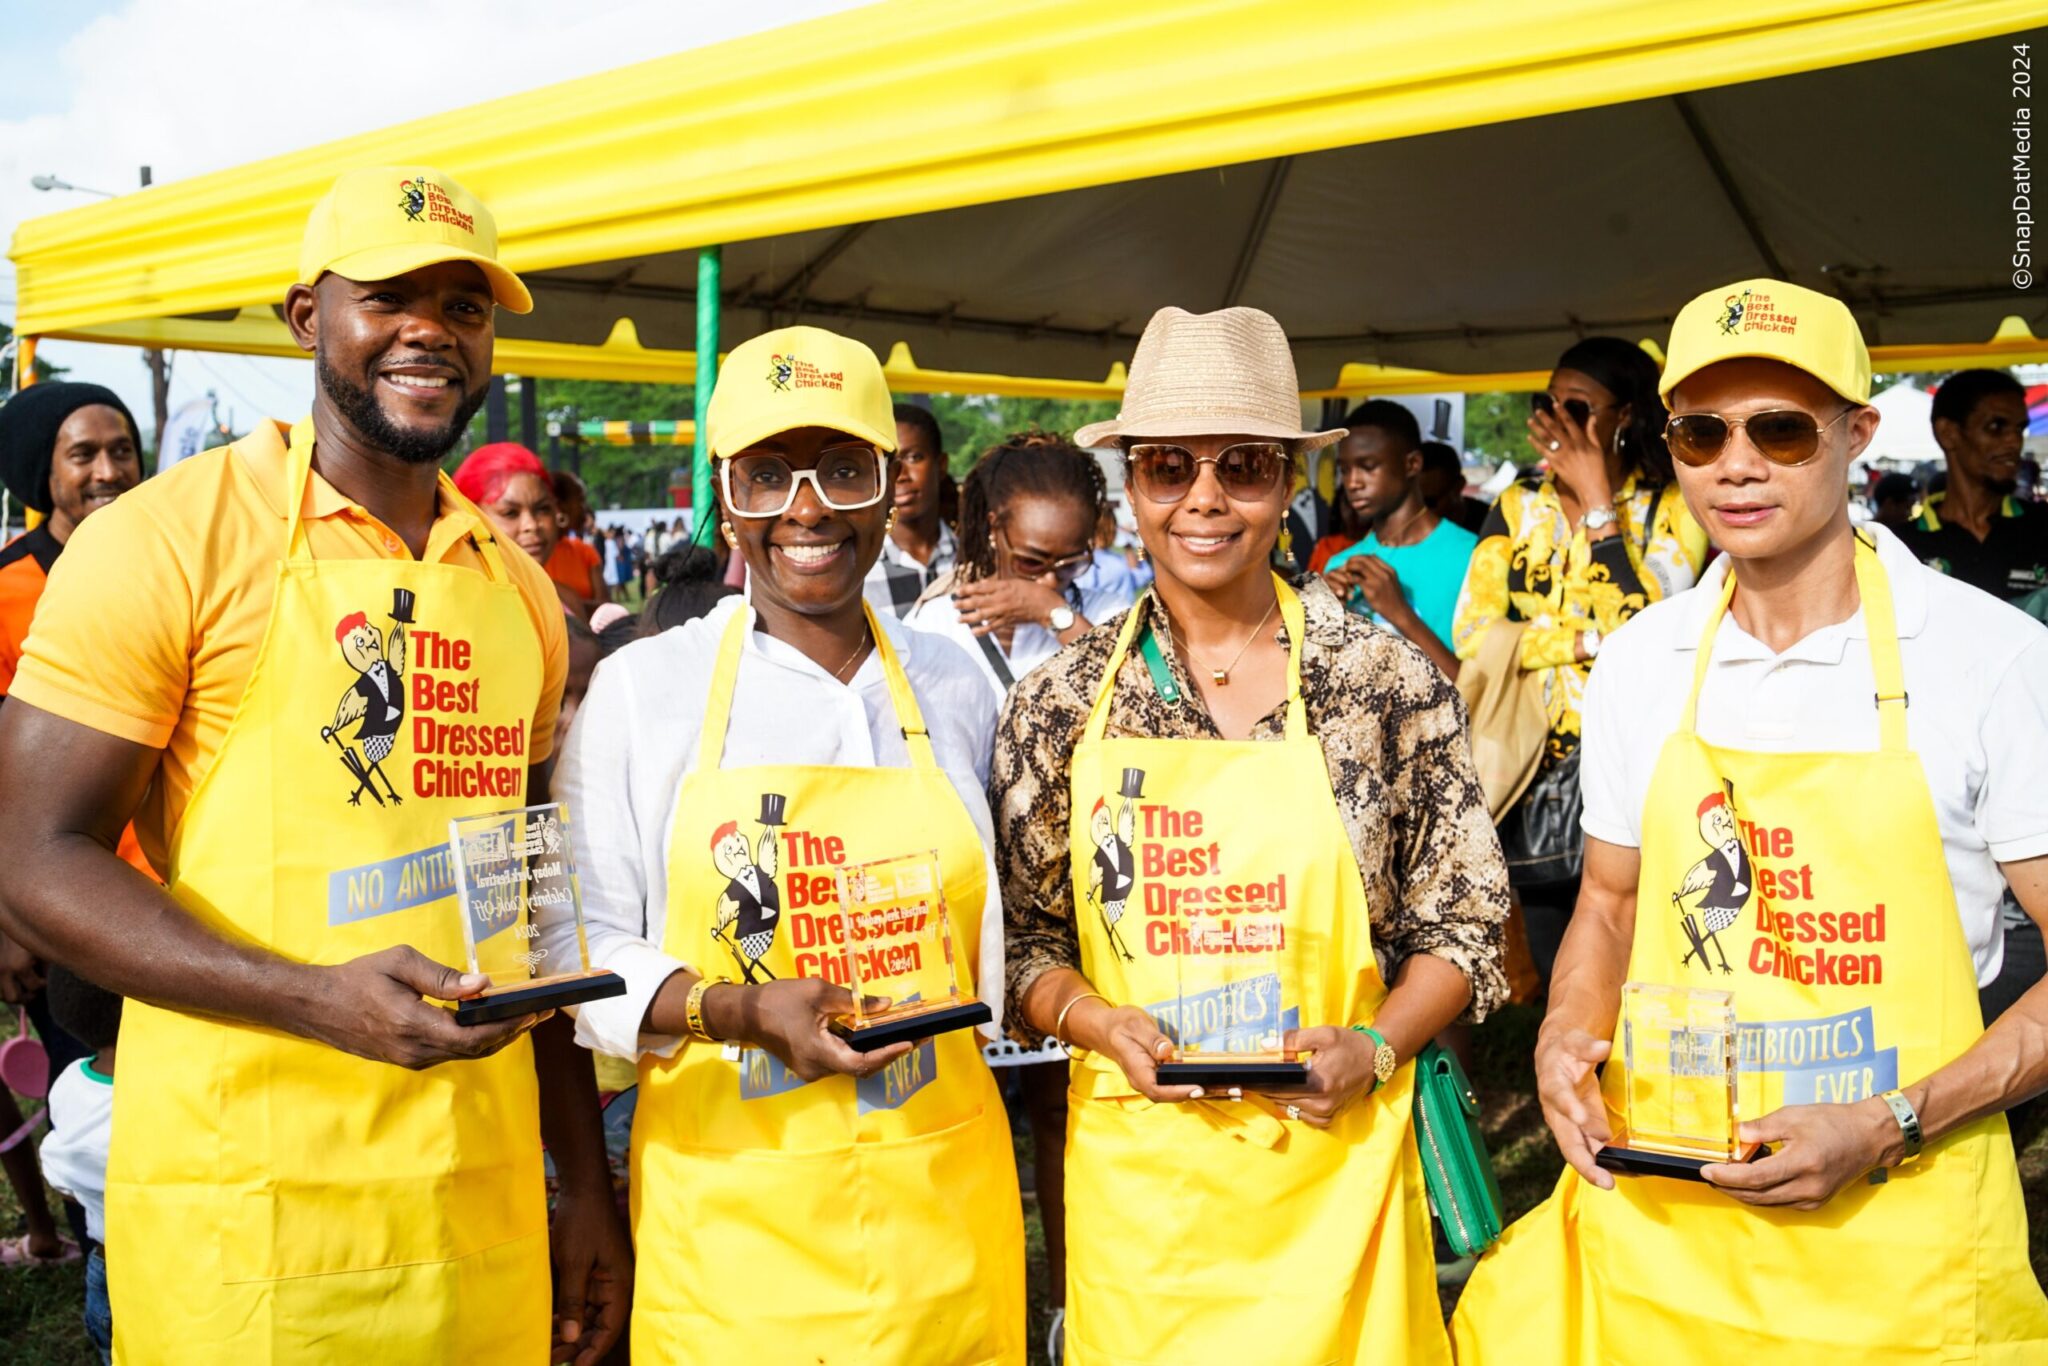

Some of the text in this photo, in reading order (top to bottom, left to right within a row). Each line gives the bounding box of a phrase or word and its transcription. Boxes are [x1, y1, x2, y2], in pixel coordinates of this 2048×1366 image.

[426, 183, 446, 196] The
[428, 192, 453, 206] Best
[429, 201, 474, 226] Dressed
[429, 212, 475, 235] Chicken
[1746, 302, 1775, 311] Best
[1748, 294, 1770, 302] The
[1744, 321, 1795, 335] Chicken
[1745, 311, 1797, 325] Dressed
[794, 360, 814, 368] The
[795, 378, 843, 391] Chicken
[409, 629, 472, 672] The
[411, 673, 480, 714] Best
[412, 716, 525, 758] Dressed
[412, 758, 523, 799] Chicken
[1139, 804, 1203, 838] The
[1738, 819, 1794, 859] The
[780, 831, 846, 868] The
[1142, 842, 1220, 878] Best
[347, 868, 384, 914] NO
[785, 871, 845, 910] Bes
[1143, 874, 1287, 917] Dressed
[1751, 863, 1814, 901] est
[794, 941, 923, 989] Chicken
[1748, 936, 1883, 987] Chicken
[749, 1052, 771, 1092] NO
[884, 1049, 922, 1101] EVER
[1815, 1066, 1875, 1105] EVER
